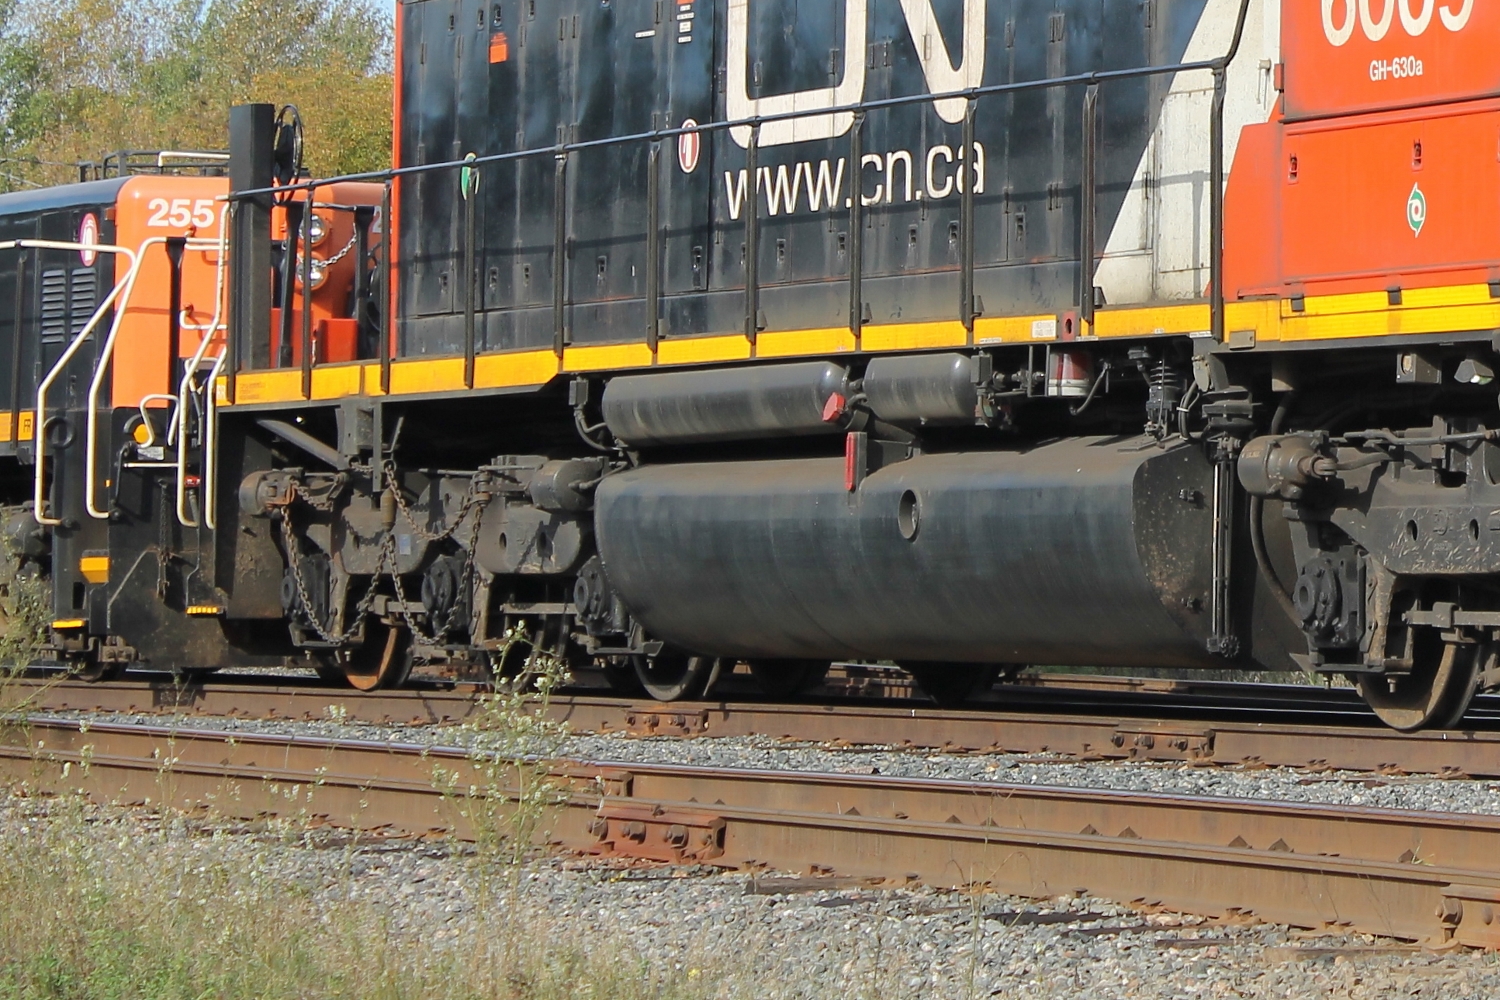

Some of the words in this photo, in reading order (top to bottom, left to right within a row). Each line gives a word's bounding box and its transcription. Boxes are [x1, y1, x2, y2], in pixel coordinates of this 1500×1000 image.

[1369, 55, 1423, 81] GH-630a
[724, 140, 985, 220] www.cn.ca
[147, 198, 215, 228] 255
